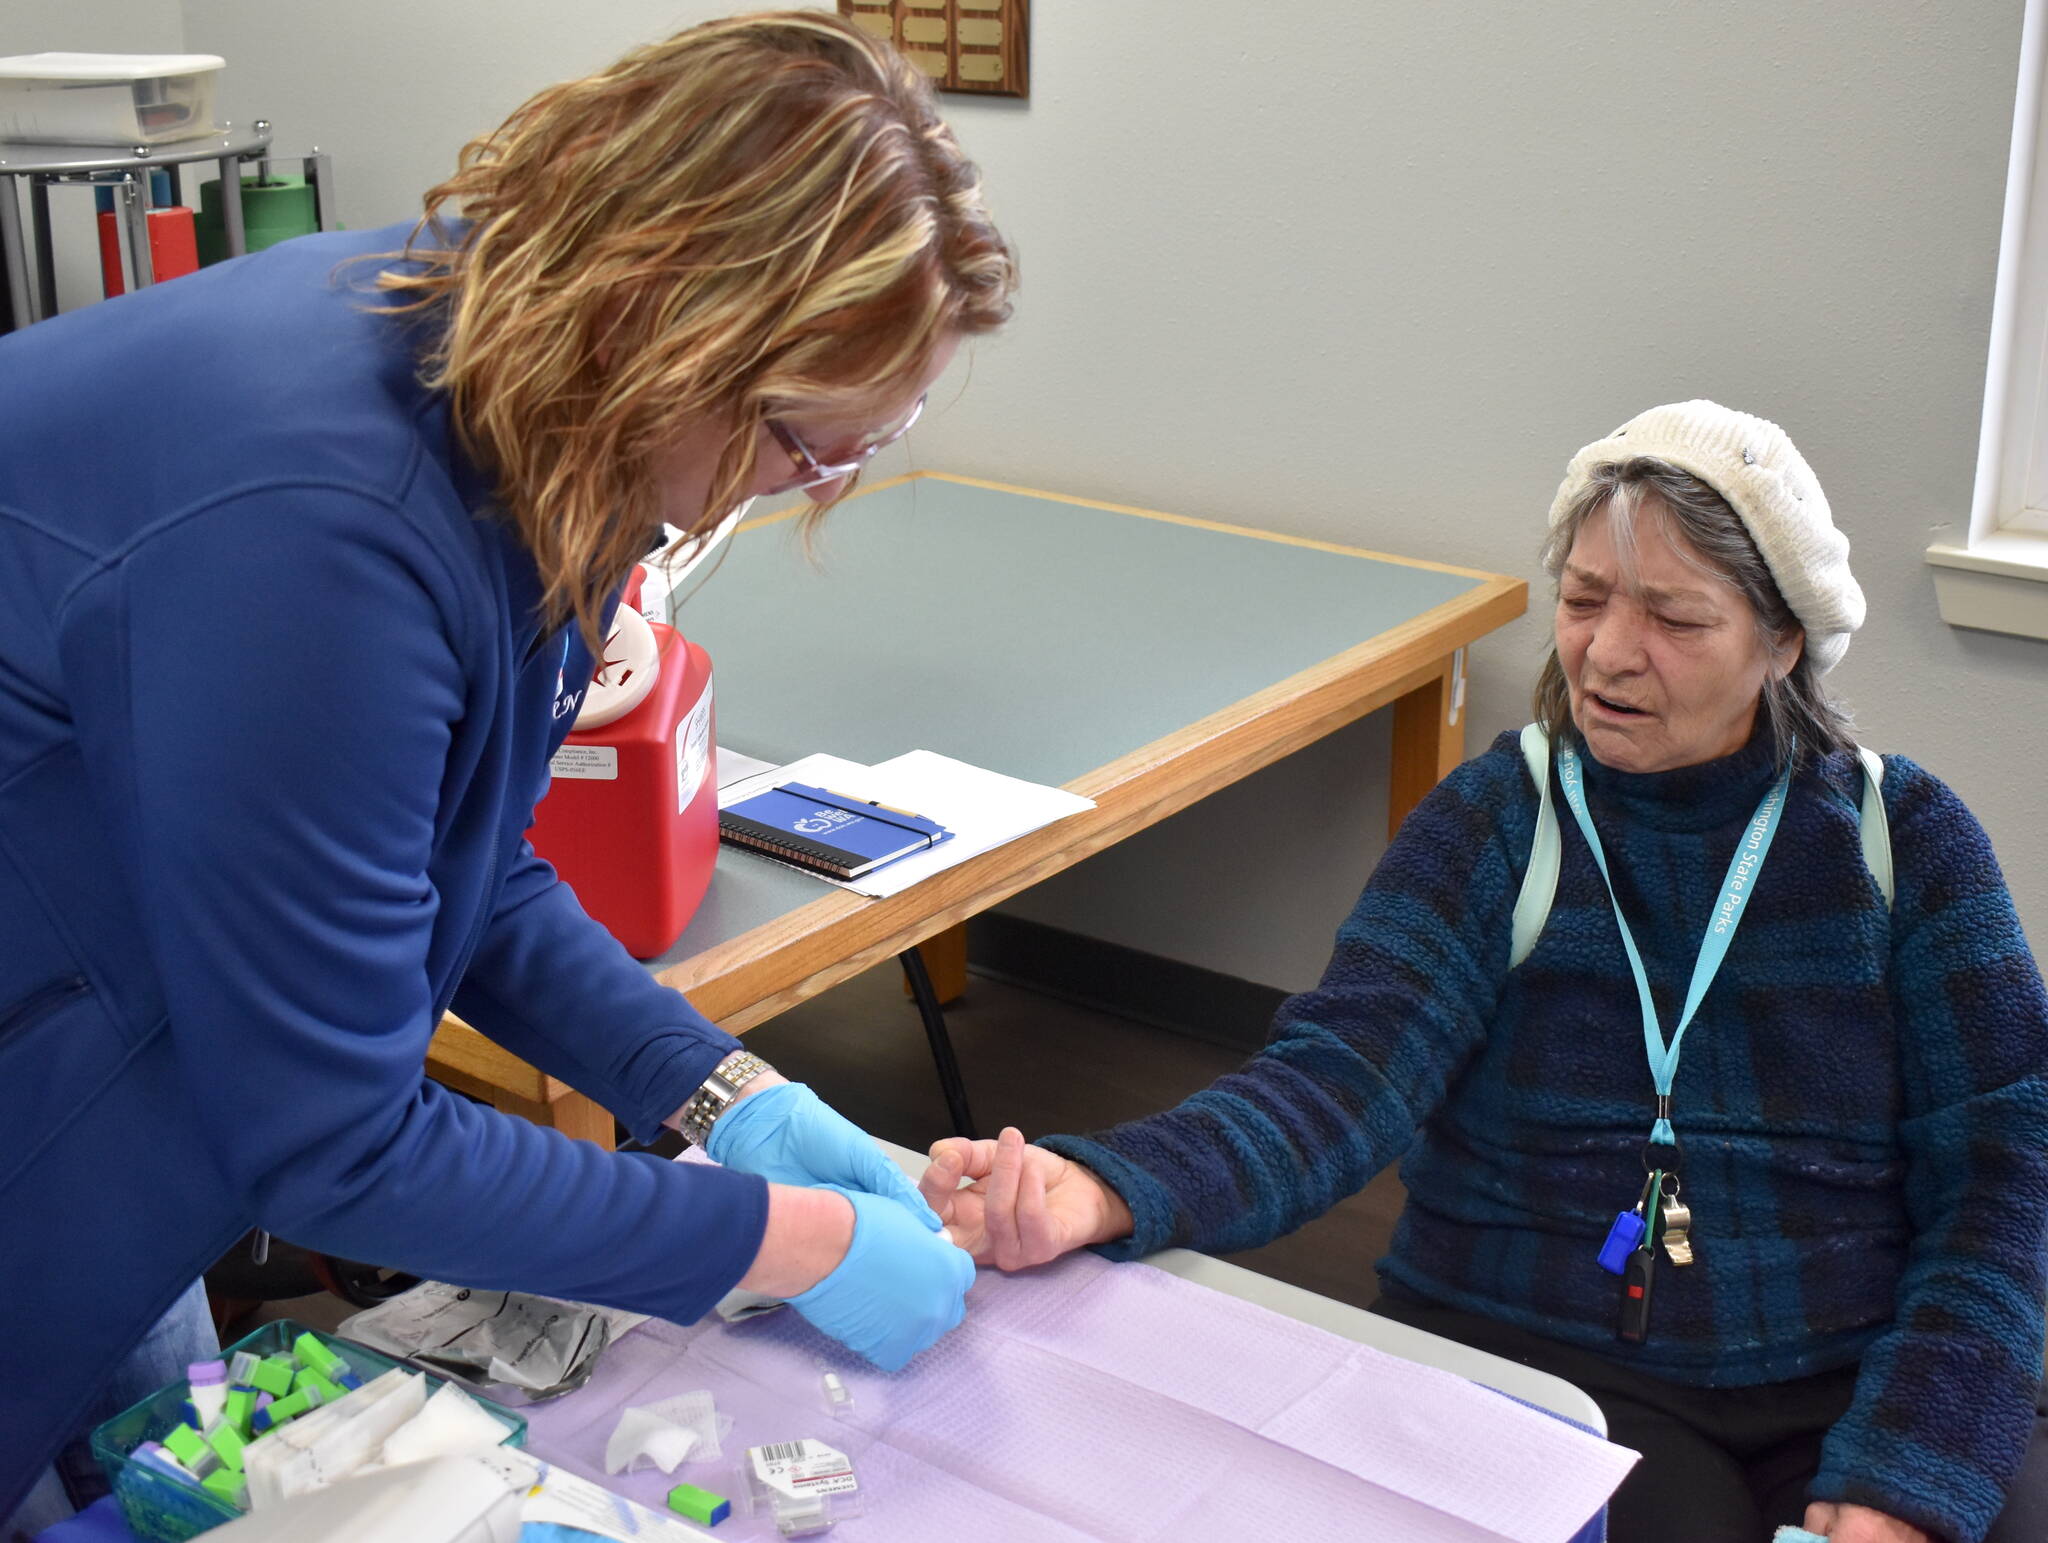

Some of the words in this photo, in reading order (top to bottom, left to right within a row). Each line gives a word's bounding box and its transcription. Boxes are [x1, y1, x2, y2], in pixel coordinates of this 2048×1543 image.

[1564, 763, 1578, 789] you
[1730, 850, 1759, 892] State
[1714, 892, 1743, 935] Parks
